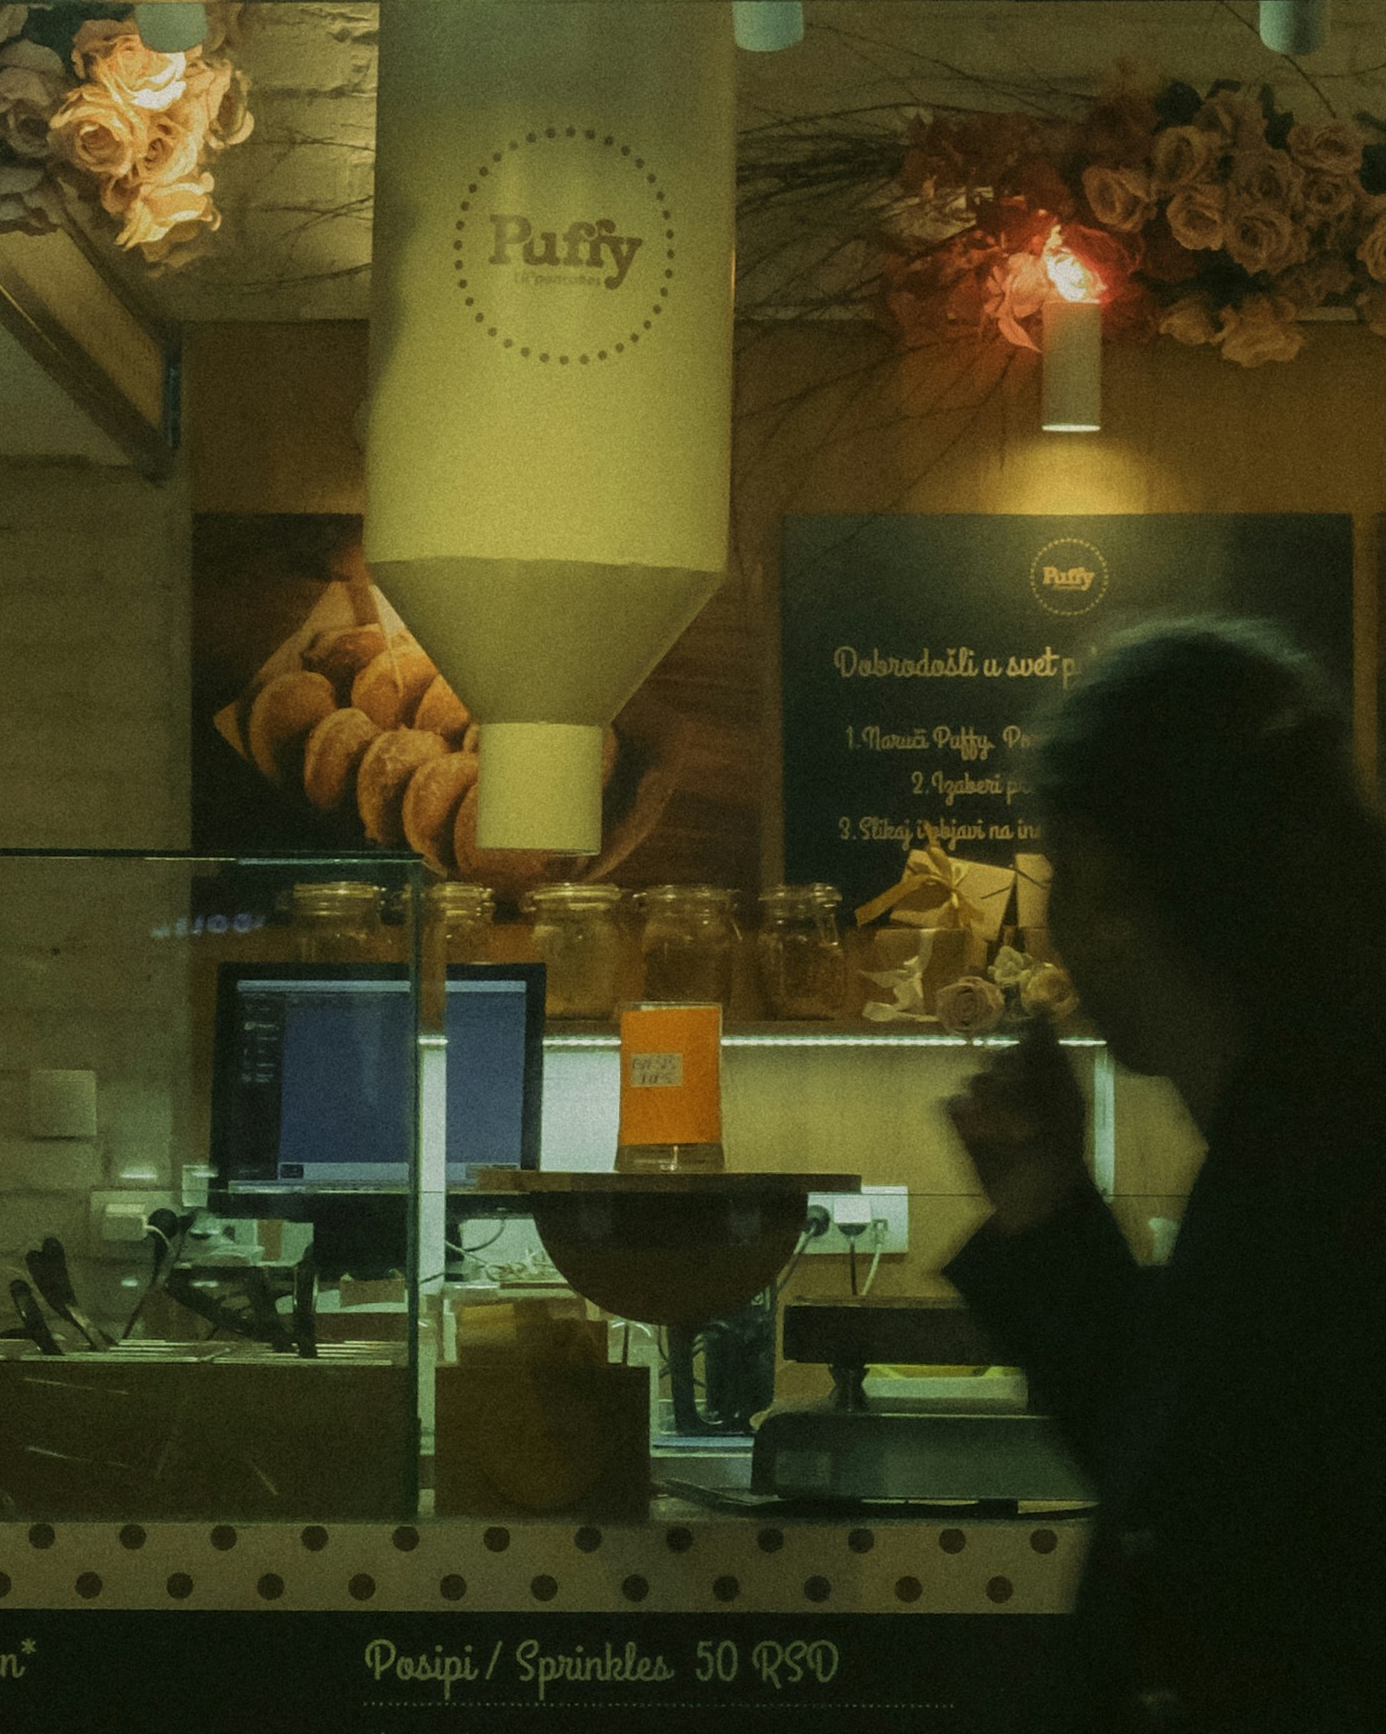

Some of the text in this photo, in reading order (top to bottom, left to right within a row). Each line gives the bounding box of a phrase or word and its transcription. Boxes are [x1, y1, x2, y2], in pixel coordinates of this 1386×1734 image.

[488, 213, 644, 290] Puffy
[1042, 565, 1096, 592] Puffy
[833, 645, 980, 679] Dobrodošli
[983, 655, 1003, 677] u
[1006, 645, 1060, 677] svet
[989, 822, 1015, 840] na
[364, 1637, 479, 1702] Posipi
[515, 1638, 676, 1702] Sprinkles
[694, 1639, 739, 1683] 50
[751, 1638, 840, 1690] RSD
